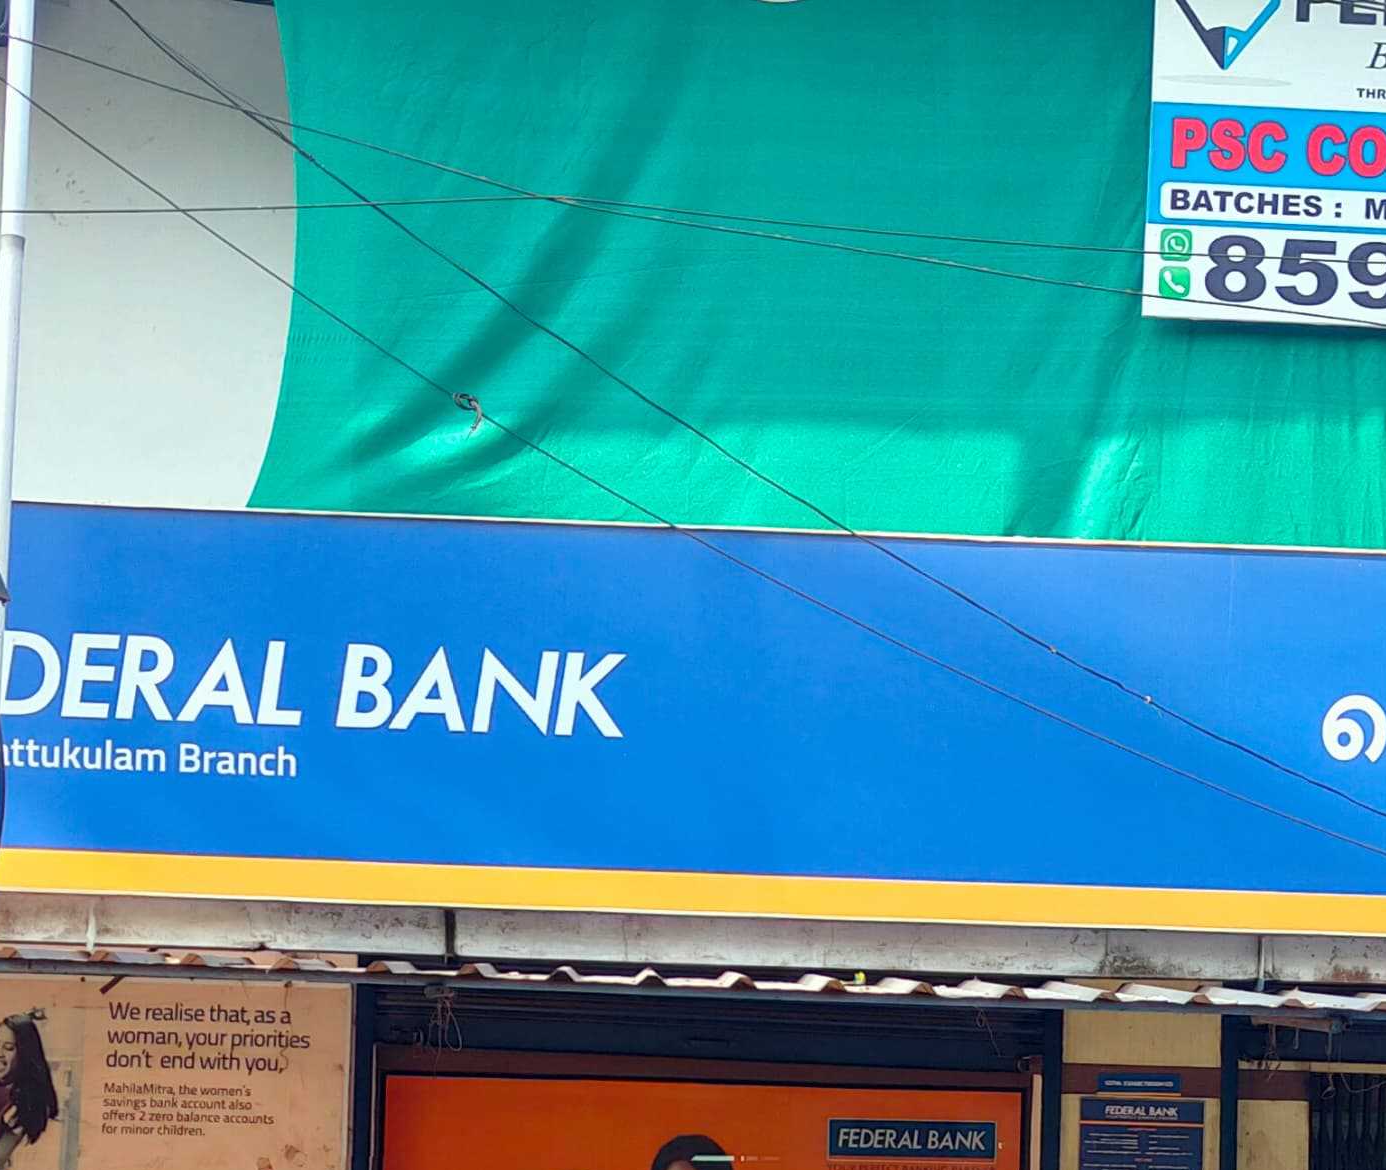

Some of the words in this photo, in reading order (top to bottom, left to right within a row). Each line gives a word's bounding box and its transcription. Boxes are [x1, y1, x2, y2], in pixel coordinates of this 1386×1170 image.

[1170, 117, 1288, 174] PSC
[1170, 188, 1323, 218] BATCHES
[334, 642, 628, 738] BANK
[179, 742, 297, 778] Branch
[109, 1002, 141, 1021] We
[145, 1003, 205, 1022] realise
[209, 1004, 250, 1024] that,
[254, 1009, 276, 1023] as
[280, 1010, 292, 1024] a
[107, 1031, 182, 1049] woman,
[185, 1033, 227, 1050] your
[230, 1030, 311, 1051] priorities
[106, 1049, 153, 1069] don't
[160, 1051, 195, 1070] end
[200, 1053, 241, 1072] with
[179, 1084, 197, 1096] the
[199, 1084, 251, 1098] women's
[103, 1099, 147, 1110] savings
[149, 1097, 178, 1109] bank
[181, 1099, 226, 1110] account
[228, 1098, 253, 1110] also
[102, 1110, 136, 1122] offers
[149, 1113, 174, 1123] zero
[176, 1111, 221, 1124] balance
[223, 1114, 275, 1126] accounts
[101, 1124, 119, 1135] for
[120, 1125, 155, 1136] minor
[157, 1125, 206, 1137] children.
[837, 1127, 922, 1149] FEDERAL
[927, 1129, 986, 1151] BANK
